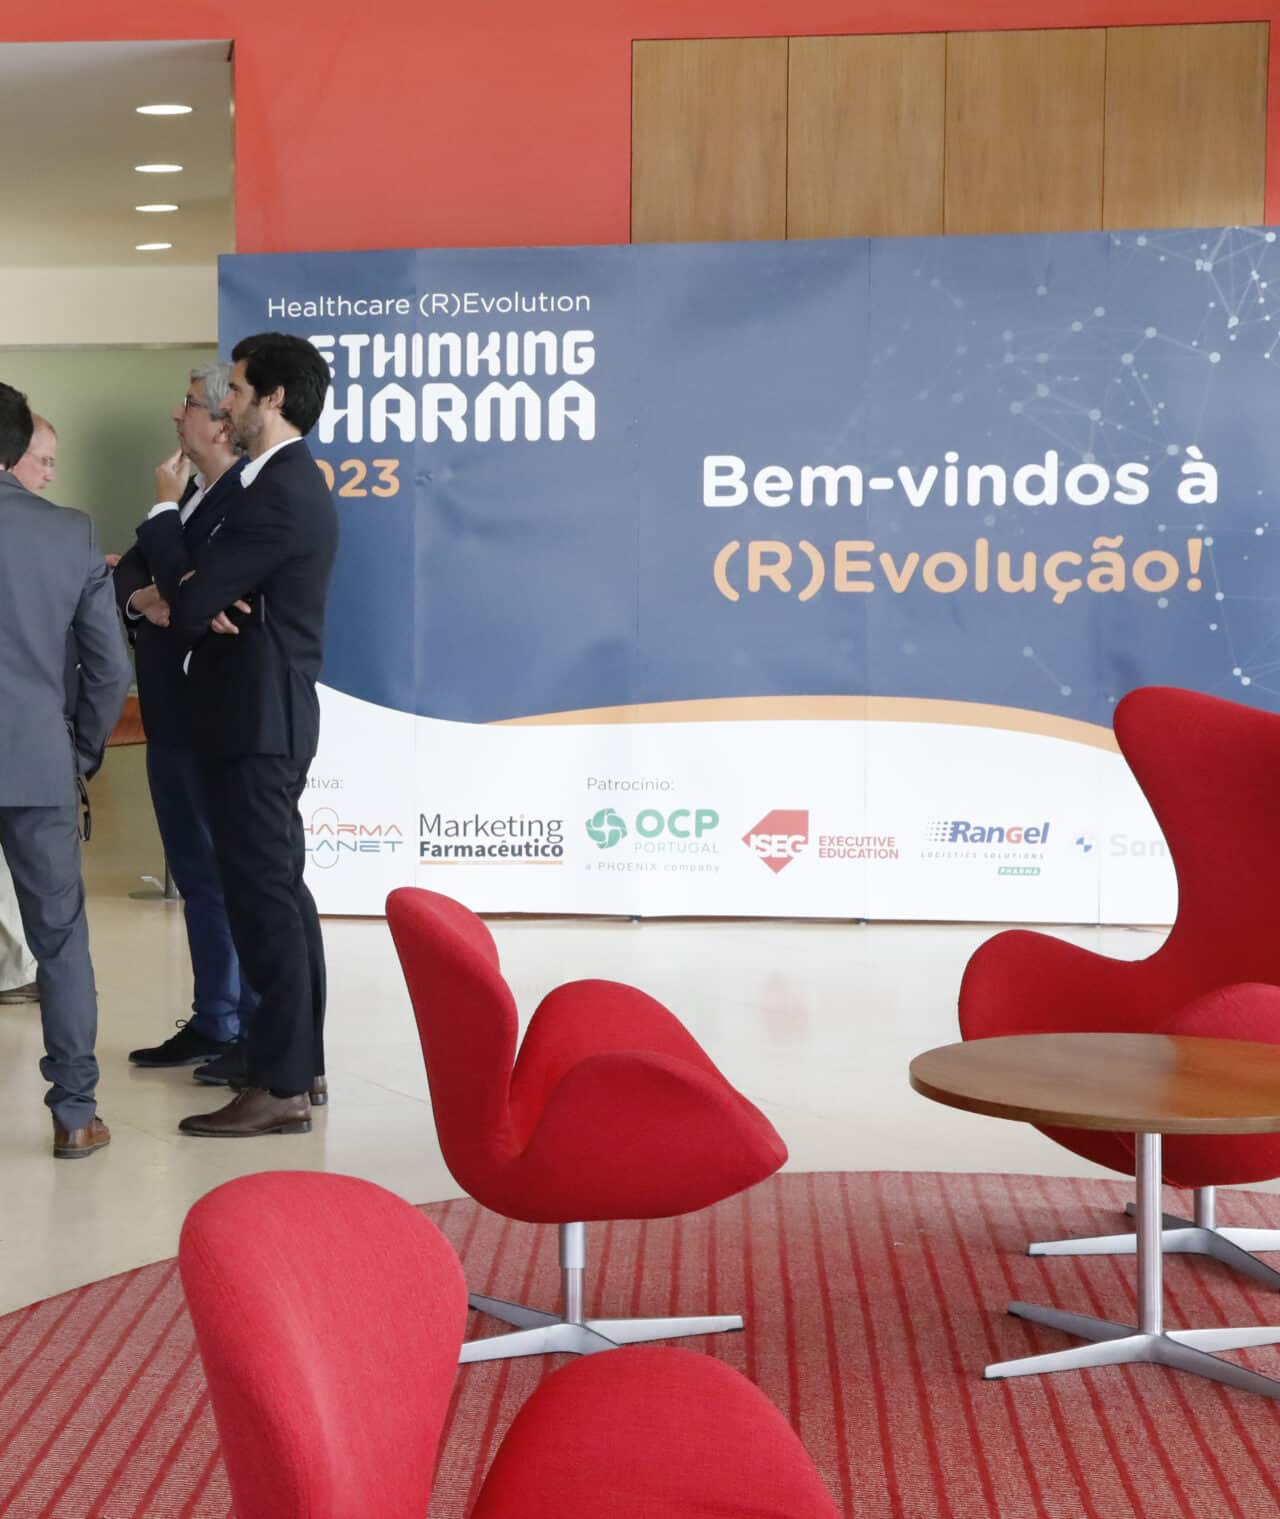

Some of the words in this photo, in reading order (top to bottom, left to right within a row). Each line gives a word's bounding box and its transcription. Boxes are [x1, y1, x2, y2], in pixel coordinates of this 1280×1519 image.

[268, 296, 410, 318] Healthcare
[420, 292, 591, 318] (R)Evolution
[307, 330, 596, 378] ETHINKING
[318, 380, 596, 443] HARMA
[703, 449, 1150, 507] Bem-vindos
[1177, 445, 1219, 504] à
[713, 535, 1205, 604] (R)Evolução!
[586, 776, 676, 792] Patrocínio:
[419, 813, 564, 844] Marketing
[635, 808, 720, 839] OCP
[419, 839, 564, 858] Farmacêutico
[634, 841, 720, 854] PORTUGAL
[748, 833, 809, 859] ISEG
[818, 835, 897, 848] EXECUTIVE
[818, 847, 900, 860] EDUCATION
[1109, 832, 1166, 857] San
[597, 862, 658, 873] PHOENIX
